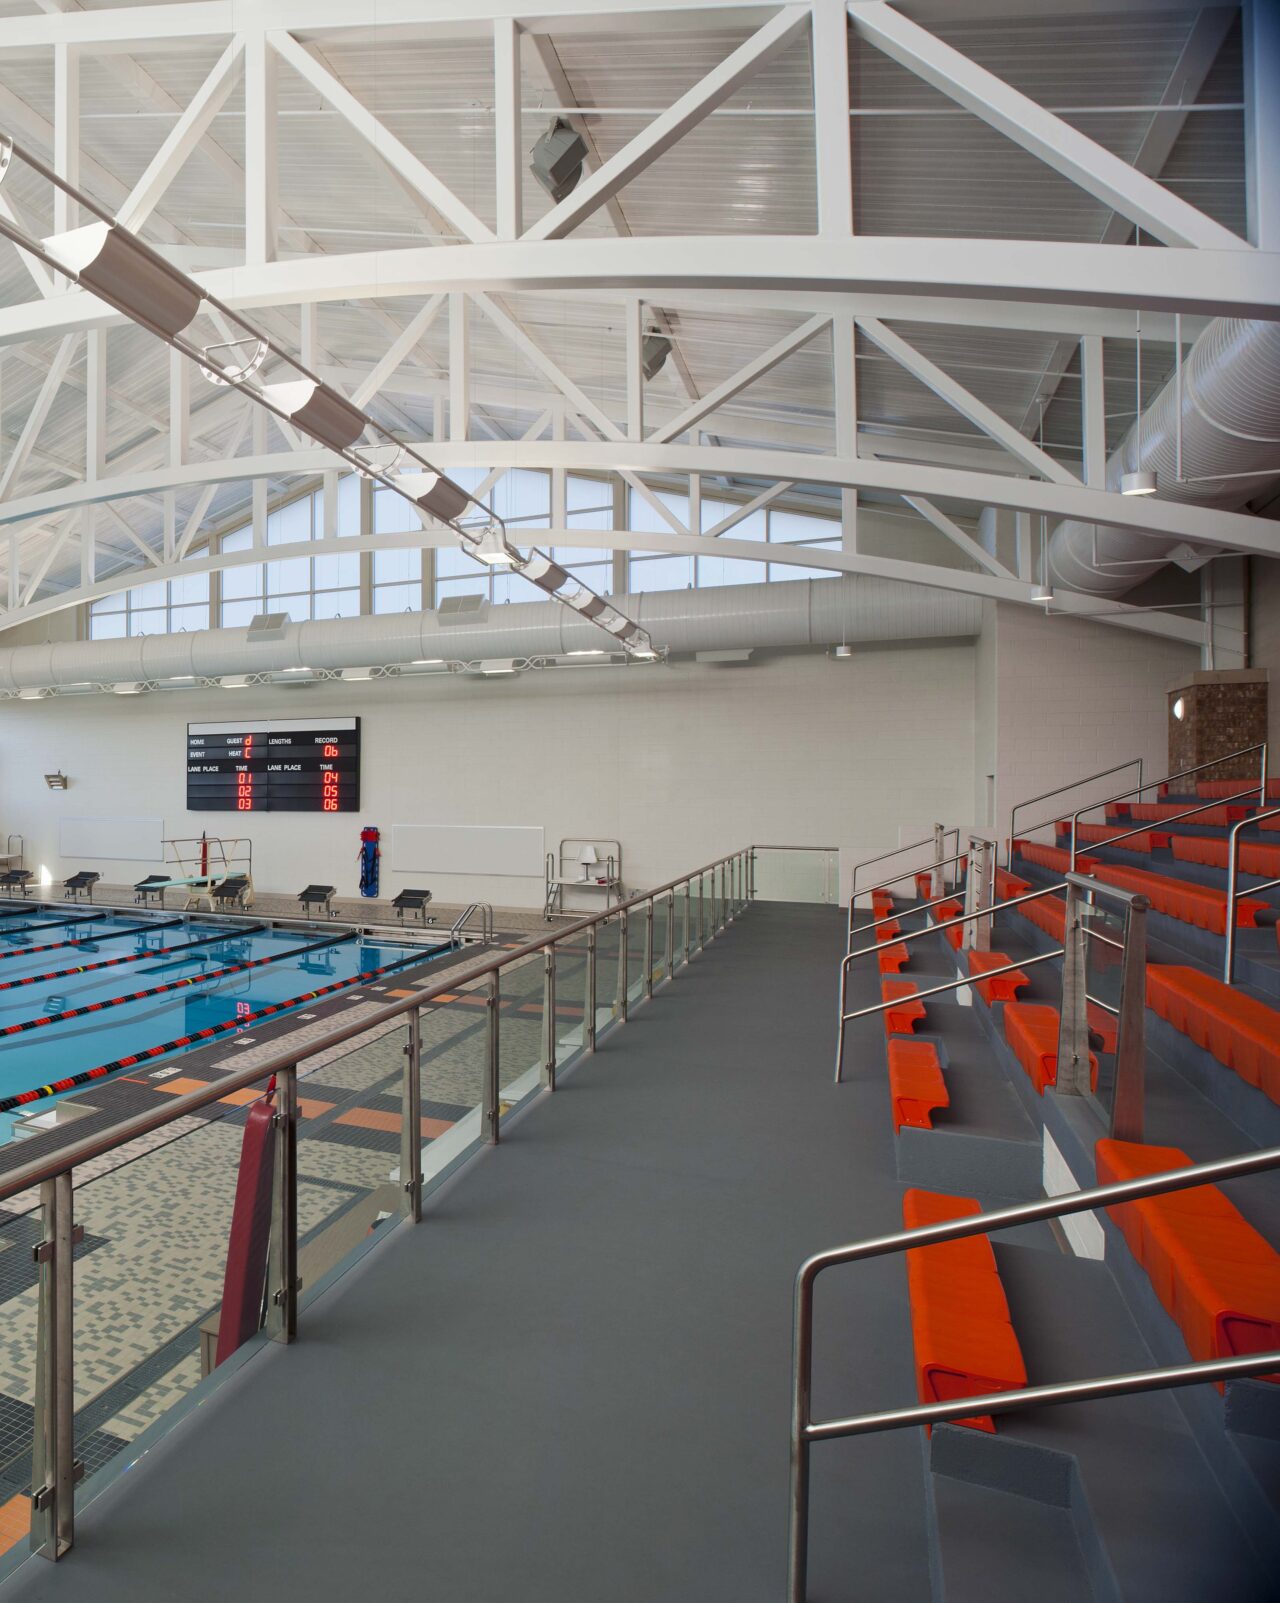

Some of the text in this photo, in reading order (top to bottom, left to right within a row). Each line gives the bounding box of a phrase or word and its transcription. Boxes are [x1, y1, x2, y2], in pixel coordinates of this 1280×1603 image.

[238, 772, 252, 784] 01
[324, 772, 338, 784] 04
[238, 785, 252, 796] 02
[324, 785, 338, 796] 05
[238, 798, 252, 810] 03
[324, 798, 338, 810] 06
